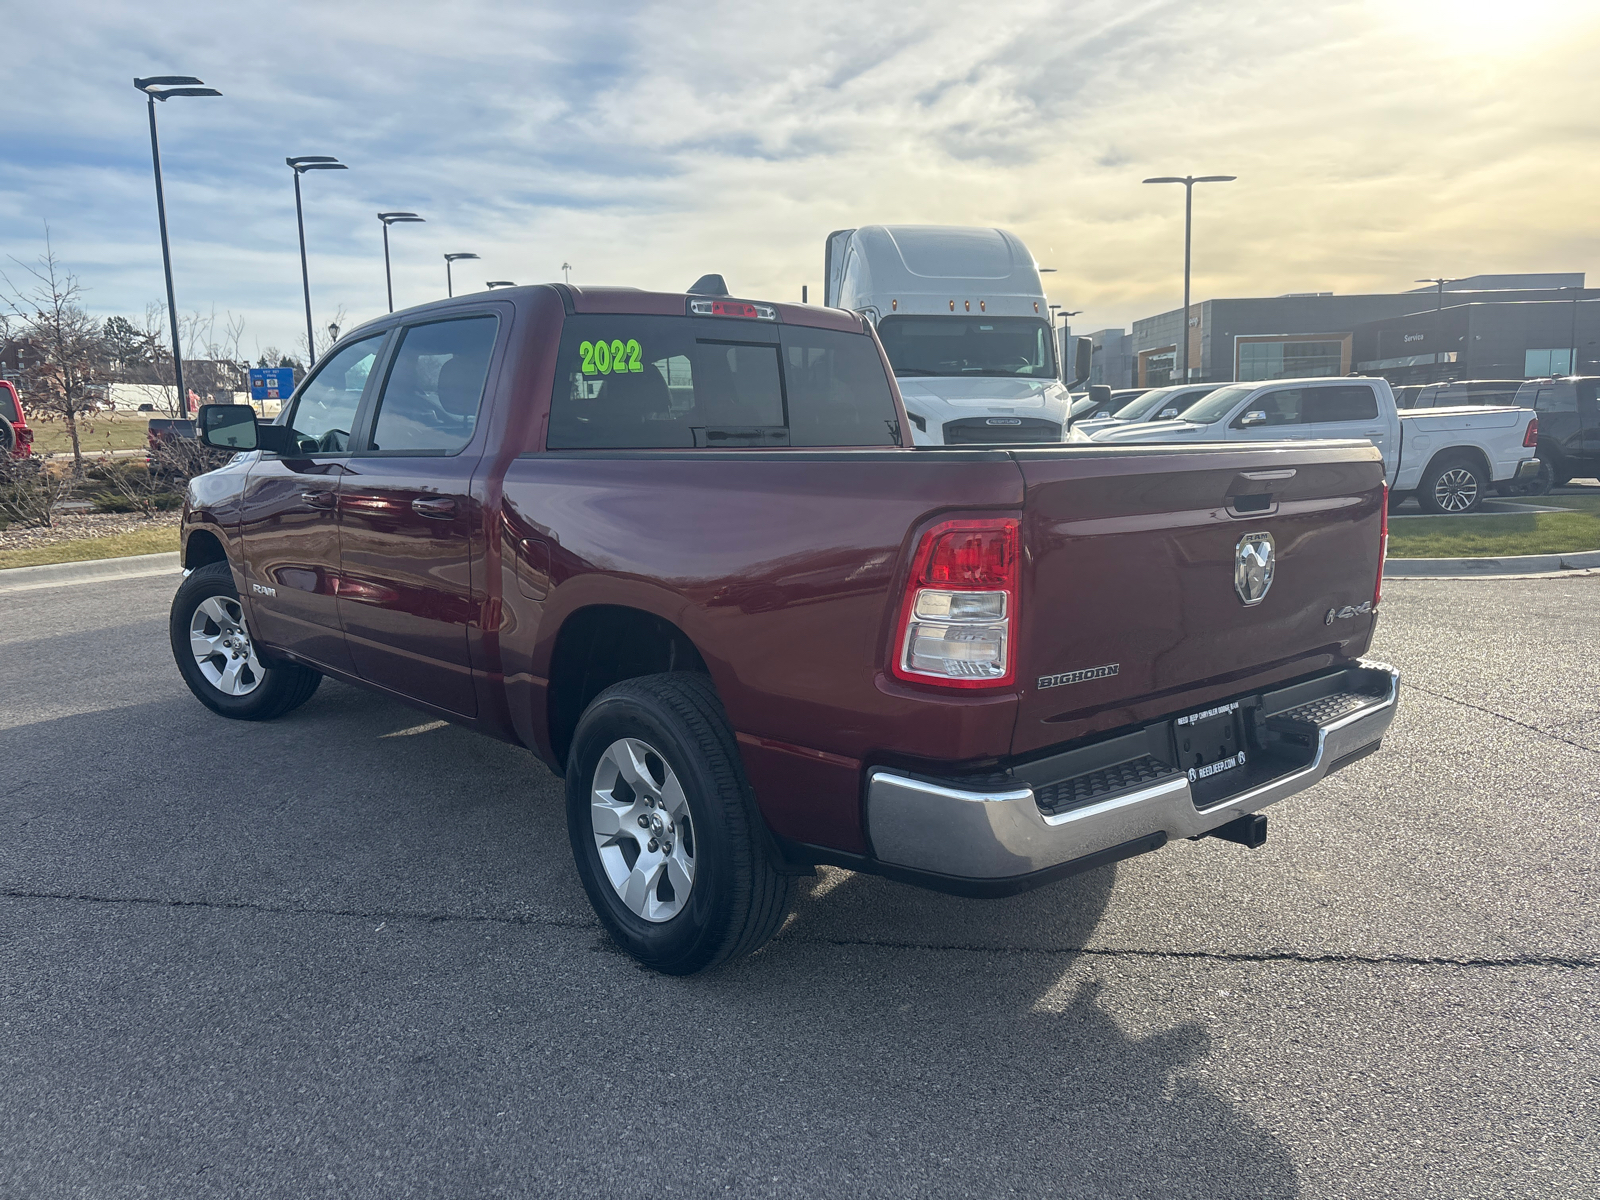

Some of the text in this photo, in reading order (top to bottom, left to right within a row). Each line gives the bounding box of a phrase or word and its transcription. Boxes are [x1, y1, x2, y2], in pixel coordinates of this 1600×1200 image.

[1404, 333, 1424, 343] Service
[579, 338, 644, 376] 2022
[1246, 533, 1268, 541] RAM
[252, 583, 277, 598] RAM
[1037, 663, 1120, 690] BIGHORN
[1178, 702, 1239, 725] REED JEEP CHRYSLER DODGE RAM
[1198, 758, 1237, 779] REEDJEEP.COM
